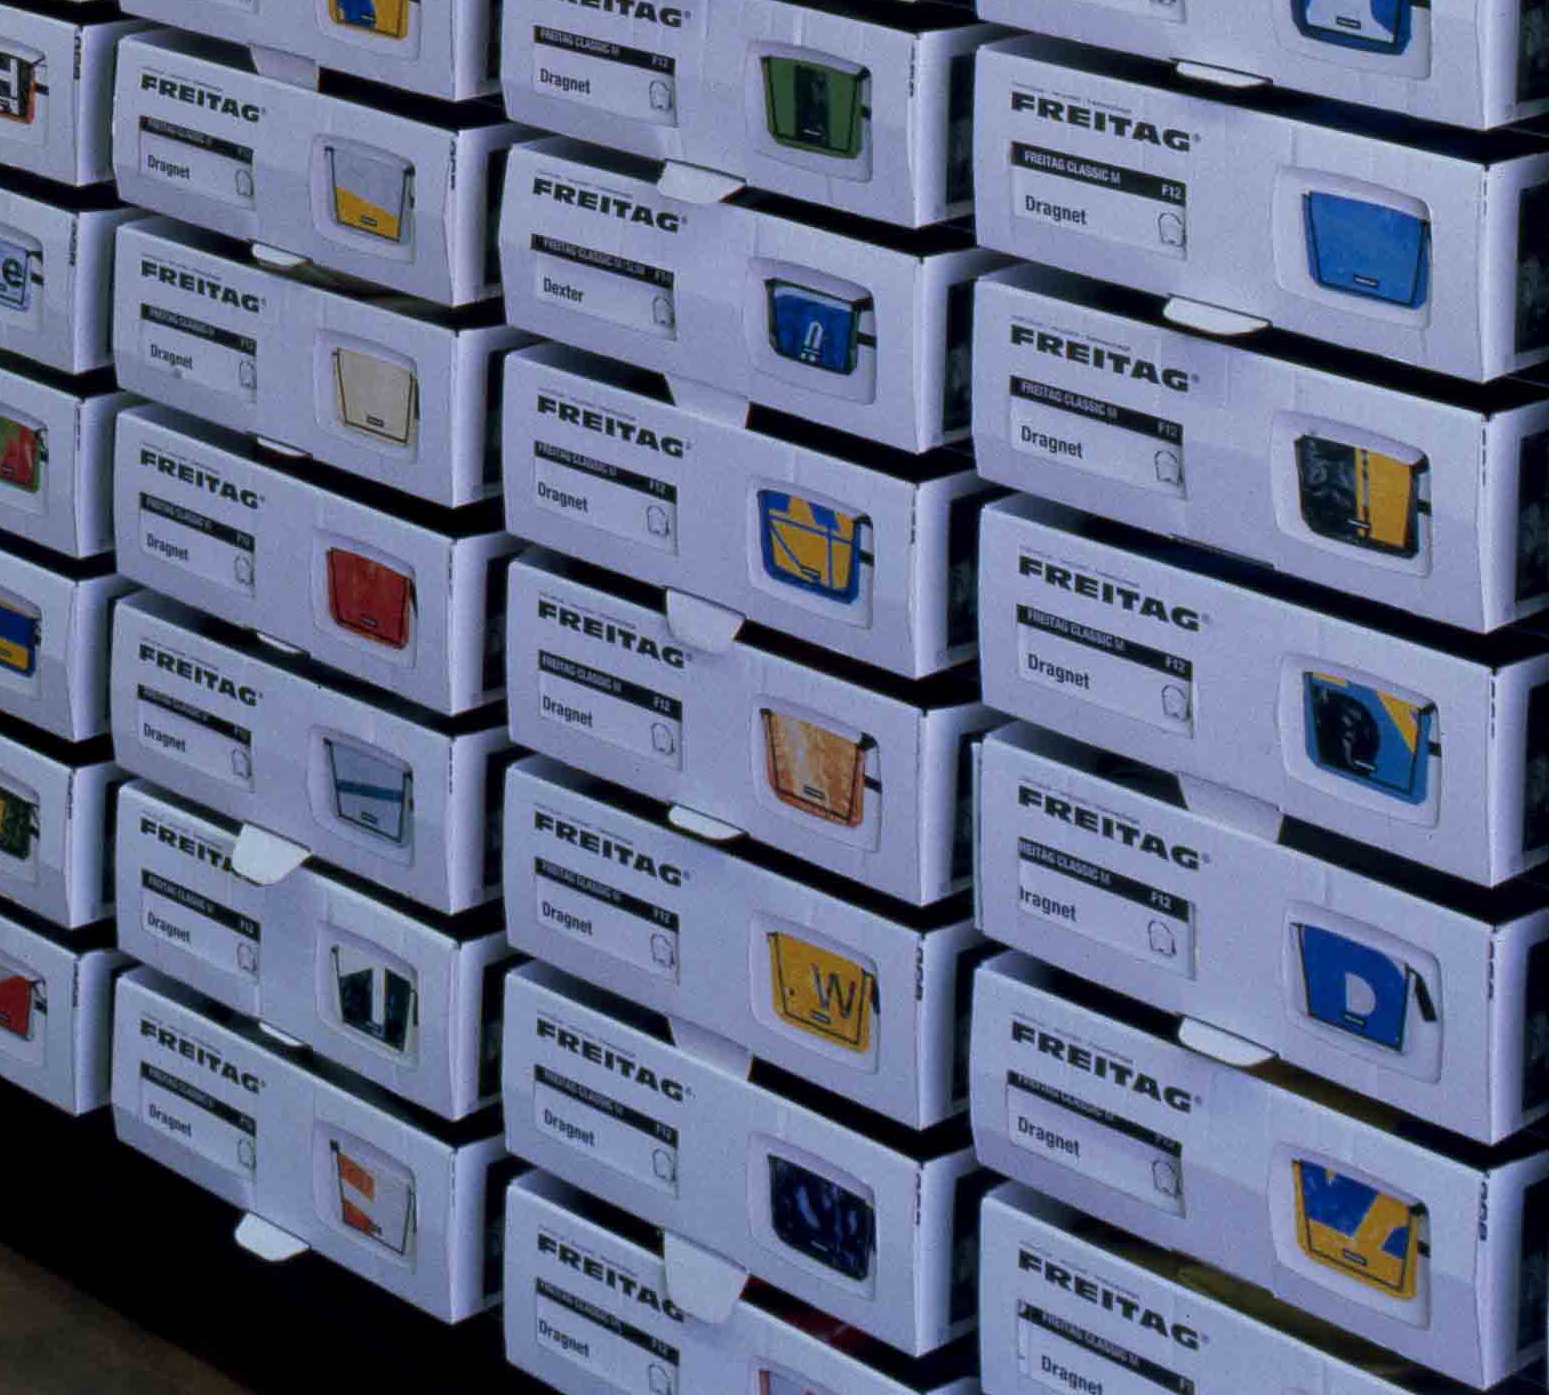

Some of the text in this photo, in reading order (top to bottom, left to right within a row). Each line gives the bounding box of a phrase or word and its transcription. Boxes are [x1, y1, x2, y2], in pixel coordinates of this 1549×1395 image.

[541, 68, 590, 94] Dragnet
[1012, 92, 1189, 151] FREITAG
[533, 178, 679, 232] FREITAG
[1026, 195, 1086, 225] Dragnet
[142, 261, 259, 312] FREITAG
[544, 277, 584, 302] Dexter
[150, 344, 192, 369] Dragnet
[1011, 325, 1188, 392] FREITAG
[1022, 426, 1082, 458] Dragnet
[141, 450, 257, 509] FREITAG
[147, 533, 188, 561] Dragnet
[1020, 556, 1198, 631] FREITAG
[539, 600, 683, 668] FREITAG
[1028, 654, 1089, 689] Dragnet
[543, 695, 592, 727] Dragnet
[535, 812, 681, 886] FREITAG
[1019, 786, 1198, 870] FREITAG
[542, 901, 592, 935] Dragnet
[1012, 1021, 1190, 1112] FREITAG
[1018, 1116, 1079, 1157] Dragnet
[1019, 1250, 1198, 1349] FREITAG
[1042, 1355, 1102, 1395] Dragnet
